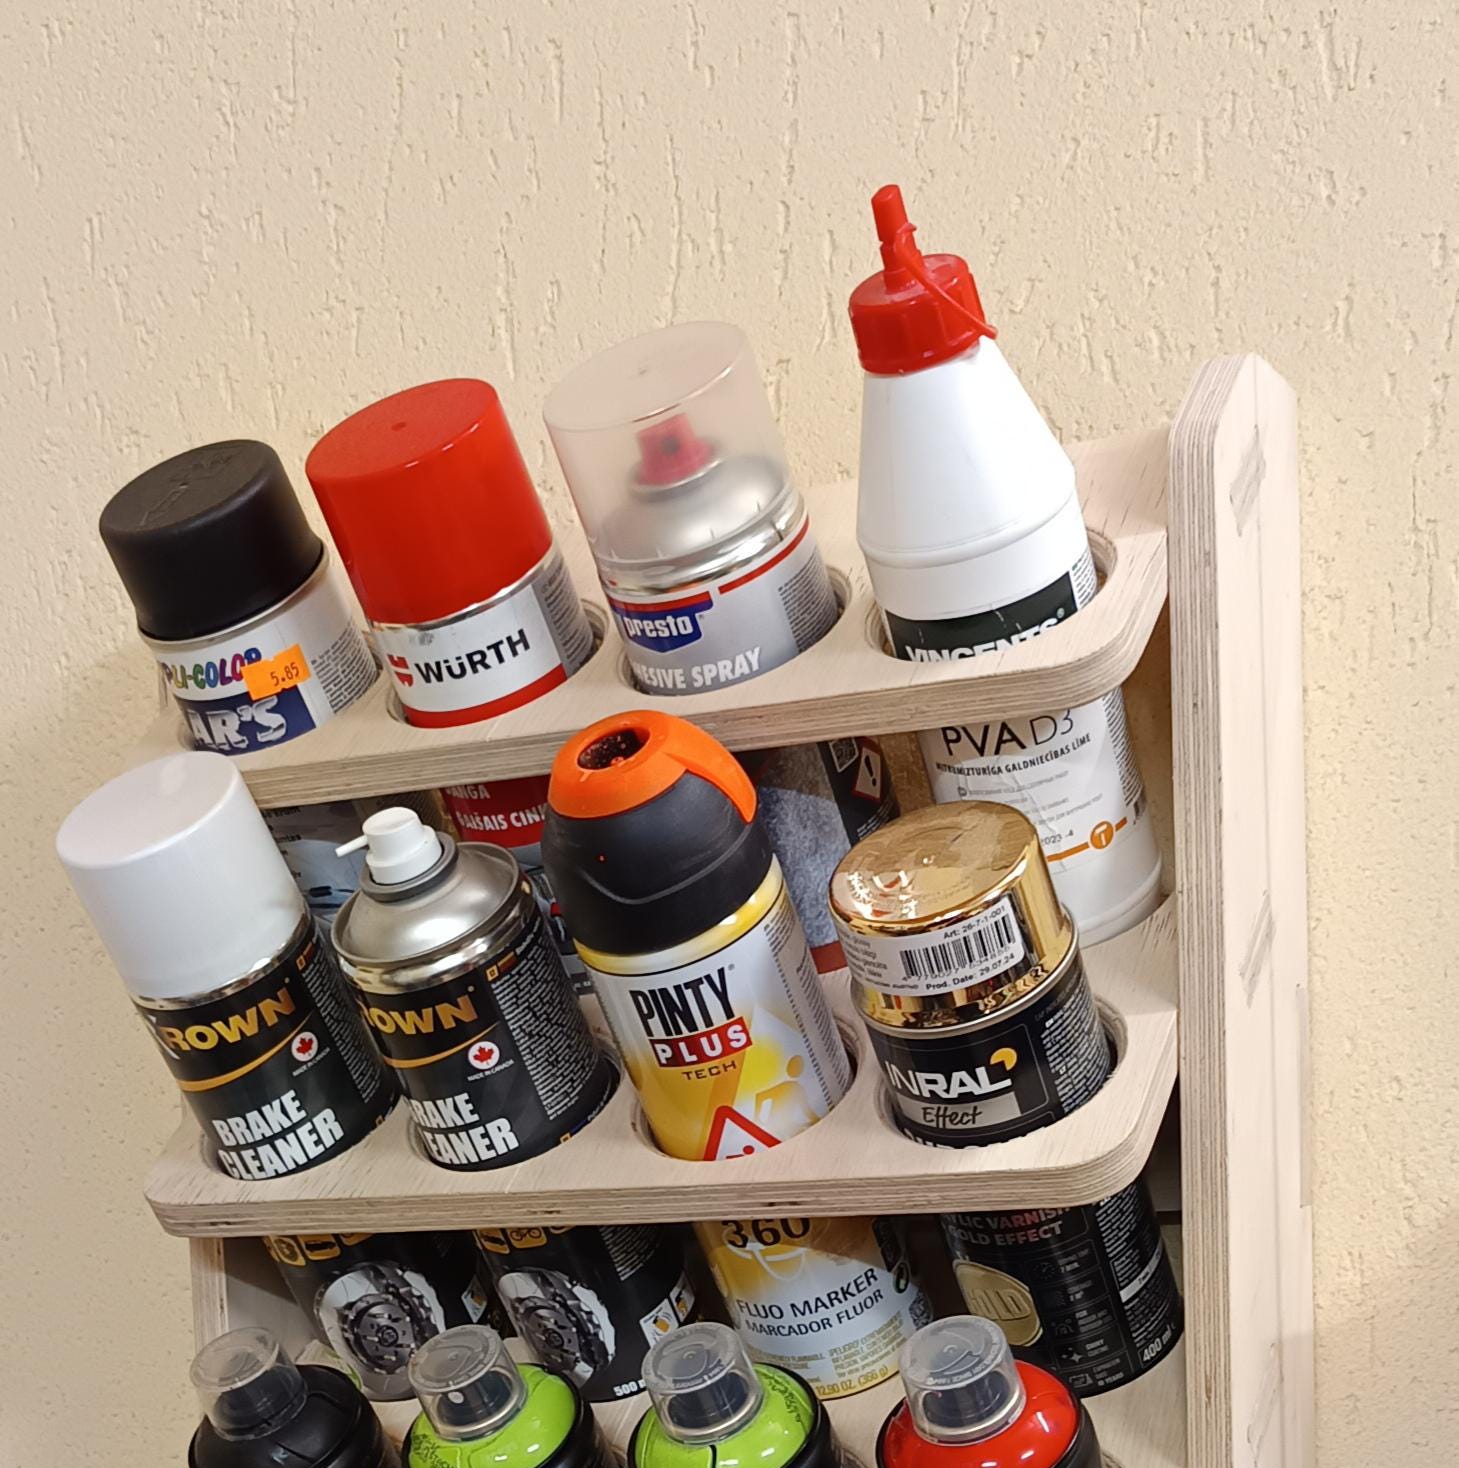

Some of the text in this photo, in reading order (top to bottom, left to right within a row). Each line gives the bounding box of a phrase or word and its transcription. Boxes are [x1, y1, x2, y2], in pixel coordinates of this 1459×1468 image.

[623, 615, 694, 638] presto
[415, 627, 531, 684] WÜRTH
[691, 646, 761, 688] SPRAY
[270, 662, 299, 687] 5.85
[940, 709, 1075, 757] PVA D3
[926, 980, 951, 991] Prod.
[952, 972, 977, 986] Date:
[629, 966, 735, 1038] PINTY
[654, 1024, 748, 1065] PLUS
[680, 1060, 738, 1081] TECH
[211, 1089, 307, 1147] BRAKE
[922, 1105, 983, 1129] Effect
[217, 1108, 344, 1181] CLEANER
[720, 1217, 811, 1249] 360
[993, 1220, 1063, 1246] EFFECT
[736, 1267, 879, 1320] FLUO MARKER
[749, 1288, 884, 1337] MARCADOR FLUOR
[1141, 1335, 1163, 1363] 400
[613, 1381, 638, 1397] 500
